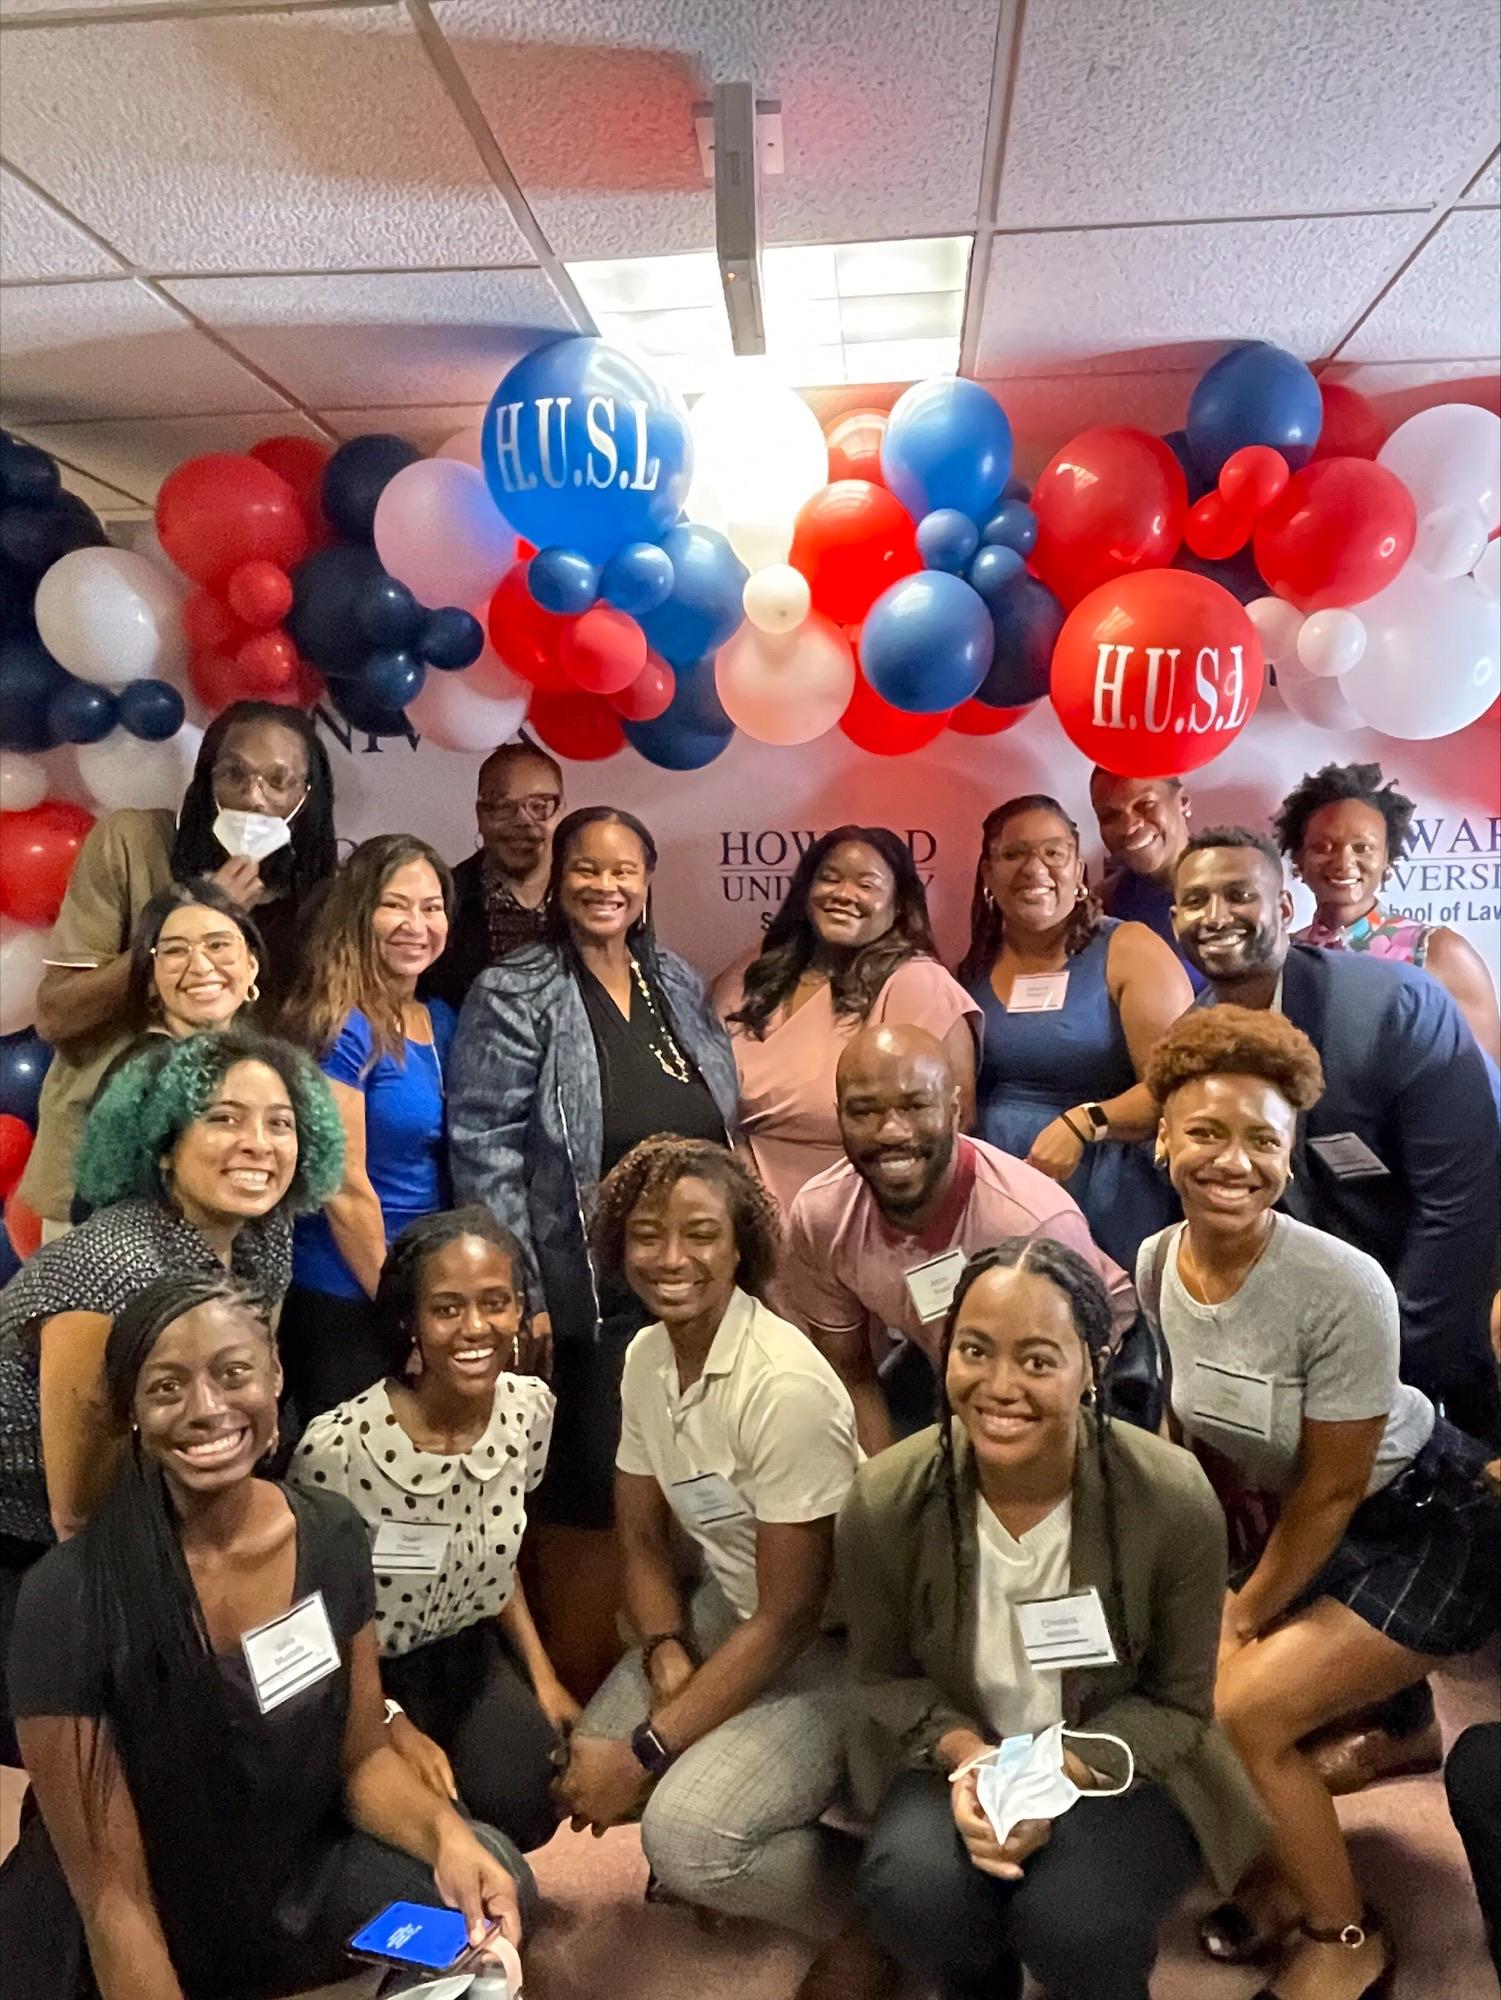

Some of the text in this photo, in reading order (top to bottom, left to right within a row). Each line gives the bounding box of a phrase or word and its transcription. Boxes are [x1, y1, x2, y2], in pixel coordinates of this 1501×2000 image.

[495, 396, 661, 493] H.U.S.L
[1092, 643, 1250, 734] H.U.S.L
[1440, 901, 1461, 922] of
